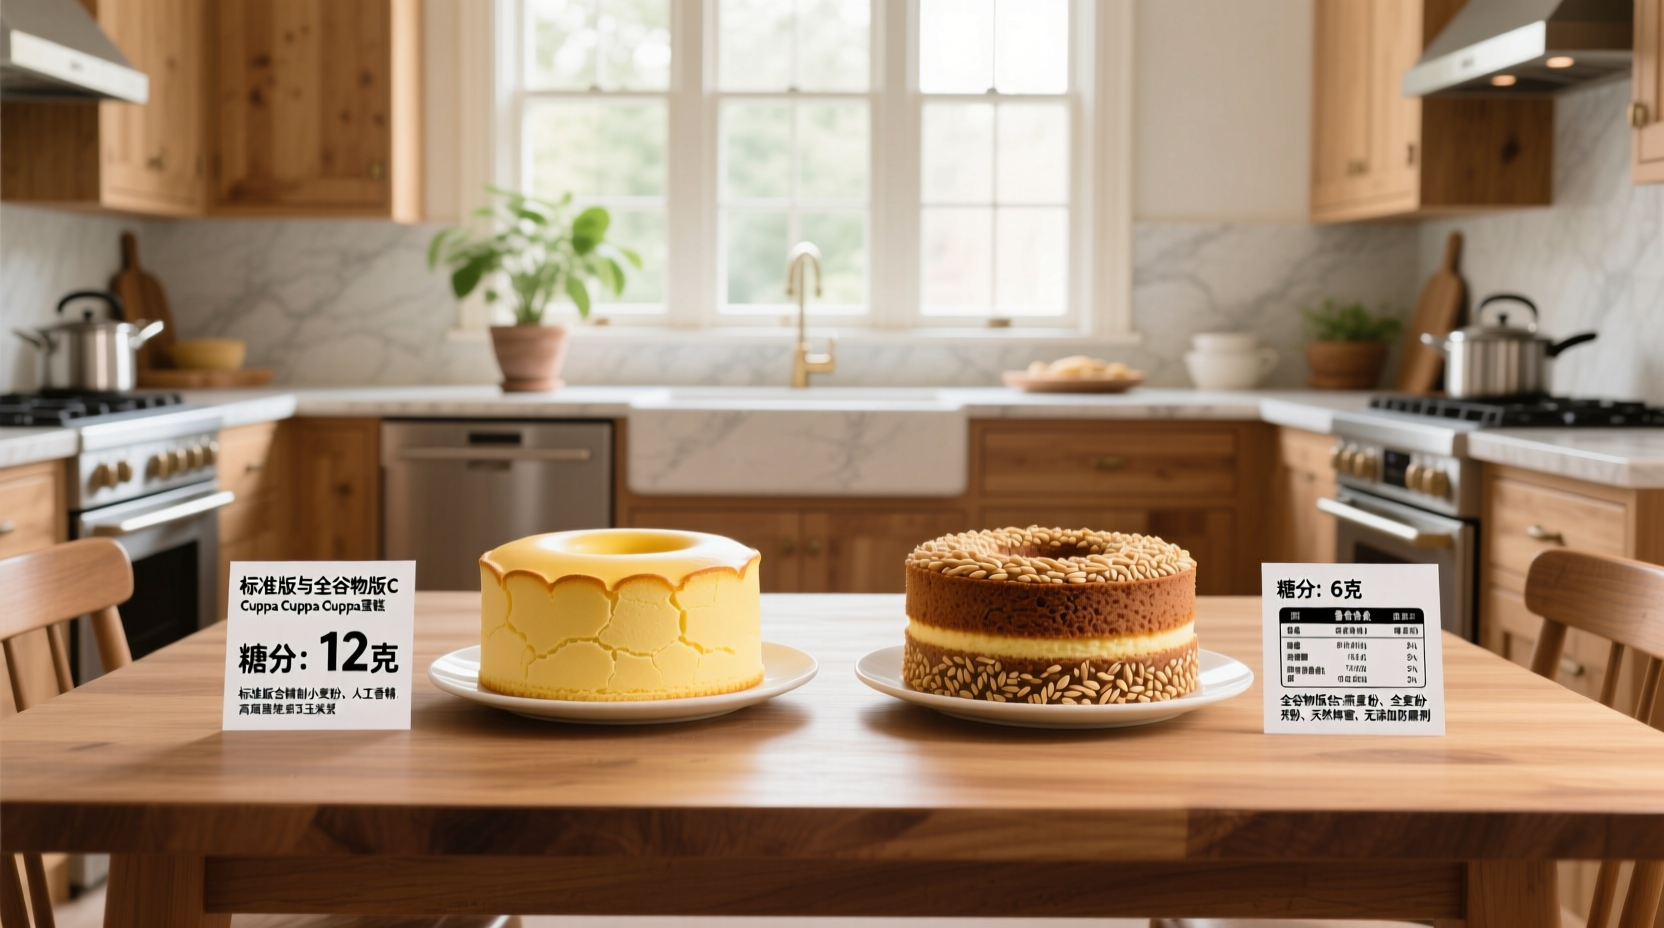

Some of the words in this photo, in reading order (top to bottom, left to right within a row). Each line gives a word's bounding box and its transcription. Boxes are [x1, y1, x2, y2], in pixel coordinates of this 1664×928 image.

[239, 575, 399, 596] 标准版与全谷物版C
[240, 600, 279, 615] Cuppa
[281, 600, 320, 615] Cuppa
